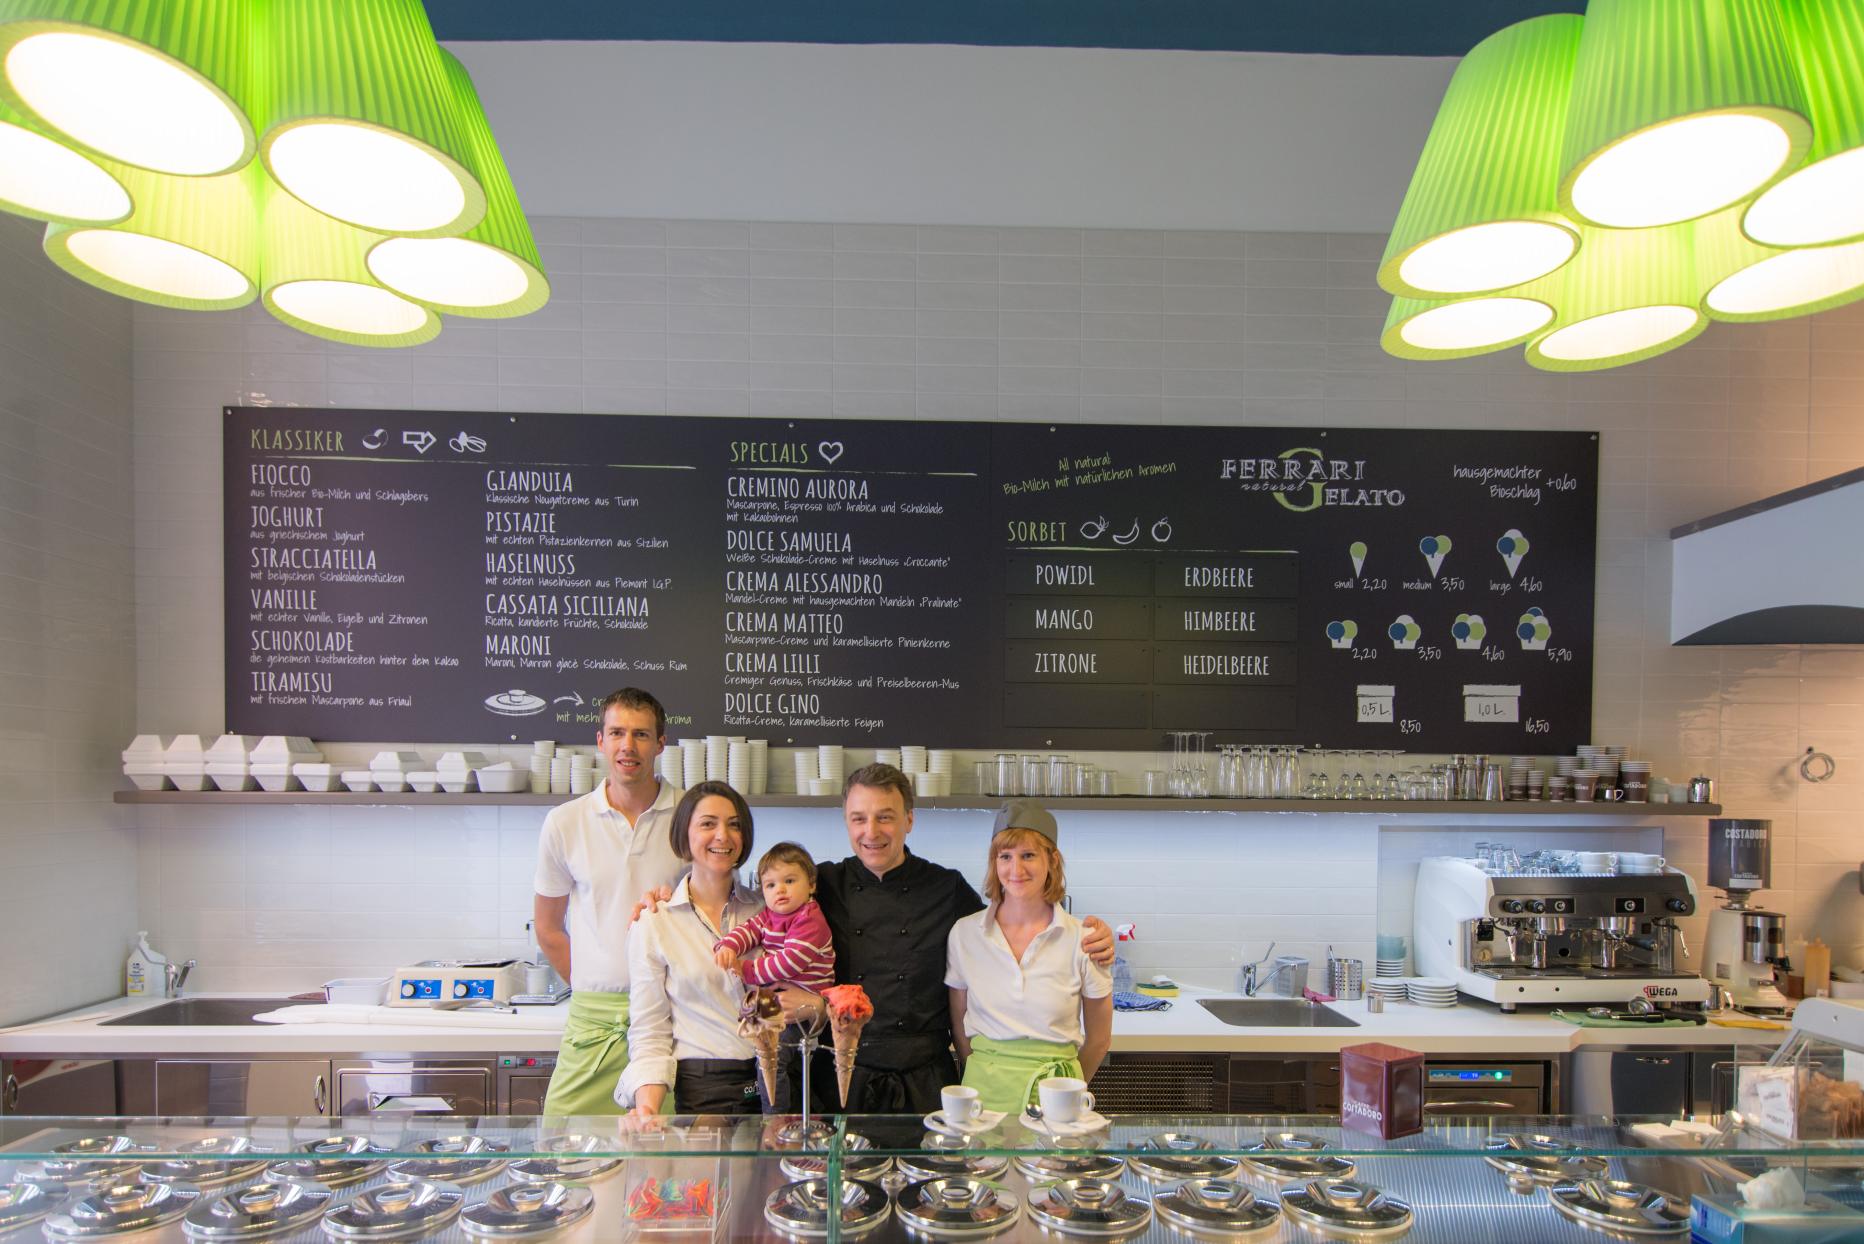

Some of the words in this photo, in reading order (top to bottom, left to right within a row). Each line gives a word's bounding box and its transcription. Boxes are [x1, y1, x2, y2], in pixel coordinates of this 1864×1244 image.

[252, 429, 344, 452] KLASSIKER
[730, 442, 809, 464] SPECIALS
[1075, 451, 1112, 470] natural
[252, 464, 311, 487] FIOCCO
[1003, 478, 1050, 495] Bio-Milch
[1055, 477, 1069, 489] mit
[1076, 467, 1134, 486] natürlichen
[1139, 462, 1177, 477] Aromen
[1221, 459, 1366, 481] FERRARI
[1453, 465, 1542, 486] hausgemachter
[487, 470, 573, 493] GIANDUIA
[728, 477, 800, 499] CREMINO
[805, 479, 868, 500] AURORA
[1241, 479, 1306, 492] natural
[1546, 473, 1577, 492] +0,60
[250, 489, 265, 498] aus
[271, 485, 306, 499] frischer
[312, 488, 351, 500] Bio-Milch
[356, 489, 371, 501] und
[376, 490, 429, 506] Schlagobers
[486, 494, 530, 505] Klassische
[535, 494, 590, 510] Nougatcreme
[595, 497, 609, 506] aus
[614, 496, 639, 507] Turin
[1490, 483, 1541, 506] Bioschlag
[252, 506, 324, 528] JOGHURT
[727, 500, 780, 512] Mascarpone,
[785, 501, 823, 514] Espresso
[827, 502, 842, 513] 100%
[847, 501, 877, 513] Arabica
[881, 502, 896, 514] und
[901, 503, 944, 515] Schokolade
[487, 512, 556, 533] PISTAZIE
[727, 512, 738, 523] mit
[744, 513, 798, 524] Kakaobohnen
[250, 531, 265, 540] aus
[270, 530, 328, 544] griechischem
[727, 530, 774, 552] DOLCE
[781, 531, 852, 553] SAMUELA
[1008, 521, 1067, 542] SORBET
[486, 536, 498, 545] mit
[503, 536, 534, 546] echten
[539, 536, 613, 548] Pistazienkernen
[617, 539, 632, 548] aus
[637, 537, 669, 549] Sizilien
[252, 547, 377, 570] STRACCIATELLA
[487, 553, 575, 575] HASELNUSS
[727, 553, 756, 564] Weiße
[761, 554, 838, 565] Schokolade-Creme
[842, 555, 854, 566] mit
[859, 556, 899, 567] Haselnuss
[251, 571, 263, 581] mit
[268, 571, 315, 585] belgischen
[320, 572, 405, 584] Schokoladenstücken
[486, 576, 498, 586] mit
[503, 576, 534, 587] echten
[539, 577, 591, 589] Haselnüssen
[596, 580, 610, 589] aus
[616, 578, 648, 590] Piemont
[726, 571, 778, 593] CREMA
[785, 572, 883, 595] ALESSANDRO
[1036, 565, 1095, 586] POWIDL
[1185, 567, 1254, 588] ERDBEERE
[1334, 579, 1354, 590] small
[1362, 578, 1388, 591] 2,20
[1403, 580, 1432, 591] medium
[1441, 577, 1465, 592] 3,50
[1490, 580, 1512, 596] large
[1520, 577, 1543, 592] 4,60
[251, 589, 317, 610] VANILLE
[487, 594, 558, 616] CASSATA
[564, 596, 649, 617] SICILIANA
[726, 593, 788, 605] Mandel-Creme
[793, 595, 804, 606] mit
[810, 594, 876, 611] hausgemachten
[880, 596, 915, 608] Mandeln
[251, 613, 263, 622] mit
[268, 613, 298, 623] echter
[338, 614, 364, 628] Eigelb
[369, 613, 384, 624] und
[389, 614, 428, 625] Zitronen
[564, 618, 600, 630] Früchte,
[605, 618, 648, 630] Schokolade
[726, 612, 778, 633] CREMA
[784, 613, 843, 635] MATTEO
[1036, 609, 1093, 630] MANGO
[1184, 611, 1256, 632] HIMBEERE
[252, 631, 354, 652] SCHOKOLADE
[487, 635, 551, 656] MARONI
[725, 634, 809, 646] Mascarpone-Creme
[814, 635, 828, 647] und
[833, 636, 893, 648] karamellisierte
[899, 637, 951, 649] Pinienkerne
[250, 652, 263, 664] die
[267, 653, 311, 668] geheimen
[316, 654, 376, 665] Kostbarkeiten
[380, 654, 407, 665] hinter
[412, 654, 429, 666] dem
[435, 656, 459, 667] Kakao
[726, 652, 778, 674] CREMA
[783, 654, 821, 674] LILLI
[1035, 653, 1097, 674] ZITRONE
[1353, 648, 1377, 660] 2,20
[1418, 647, 1442, 660] 3,50
[1482, 646, 1505, 661] 4,60
[1548, 648, 1572, 662] 5,90
[485, 657, 516, 669] Maroni,
[520, 658, 552, 669] Marron
[634, 660, 665, 671] Schuss
[670, 660, 688, 671] Rum
[1184, 655, 1270, 676] HEIDELBEERE
[252, 672, 332, 693] TIRAMISU
[725, 675, 765, 690] Cremiger
[770, 677, 803, 687] Genuss,
[808, 677, 852, 688] Frischkäse
[858, 677, 872, 688] und
[877, 678, 960, 690] Preiselbeeren-Mus
[251, 695, 263, 704] mit
[268, 693, 307, 705] frischem
[312, 694, 364, 708] Mascarpone
[369, 697, 383, 706] aus
[388, 696, 412, 707] Friaul
[726, 693, 772, 714] DOLCE
[778, 694, 820, 715] GINO
[557, 712, 570, 723] mit
[724, 715, 785, 727] Ricotta-Creme,
[790, 716, 850, 728] karamellisierte
[855, 718, 884, 733] Feigen
[1400, 720, 1422, 734] 8,50
[1525, 720, 1550, 734] 16,50
[1647, 986, 1678, 998] WEGA
